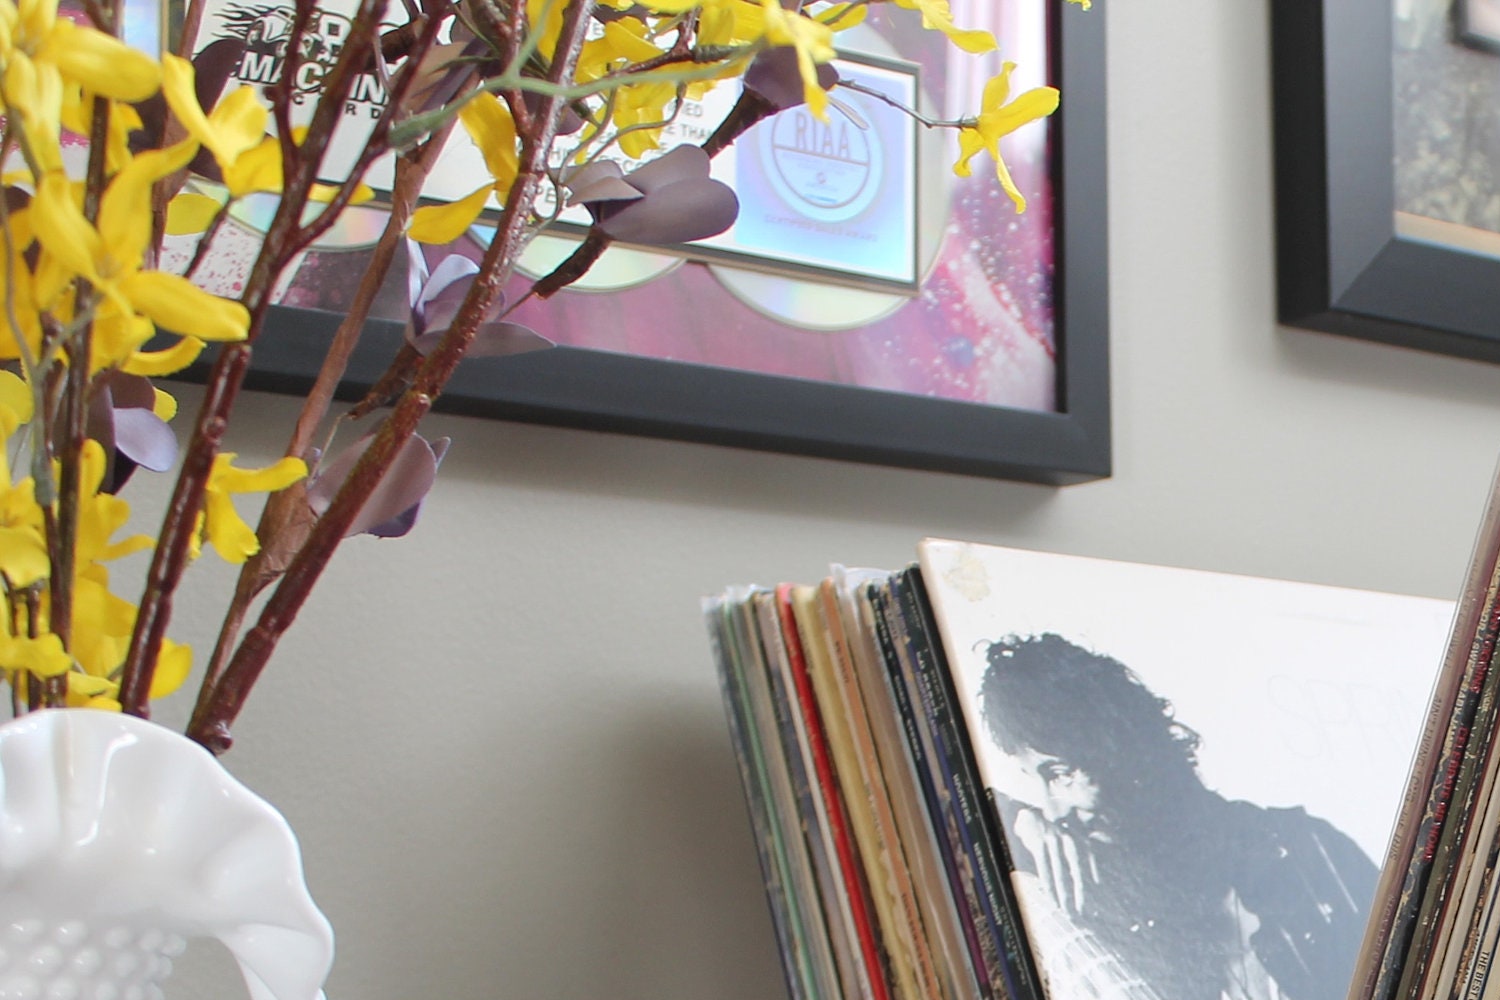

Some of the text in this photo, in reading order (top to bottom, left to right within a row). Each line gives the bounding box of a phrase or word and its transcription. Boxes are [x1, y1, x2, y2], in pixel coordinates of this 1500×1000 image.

[795, 110, 850, 162] RIAA
[1478, 951, 1489, 970] THE
[1470, 972, 1483, 997] BEST
